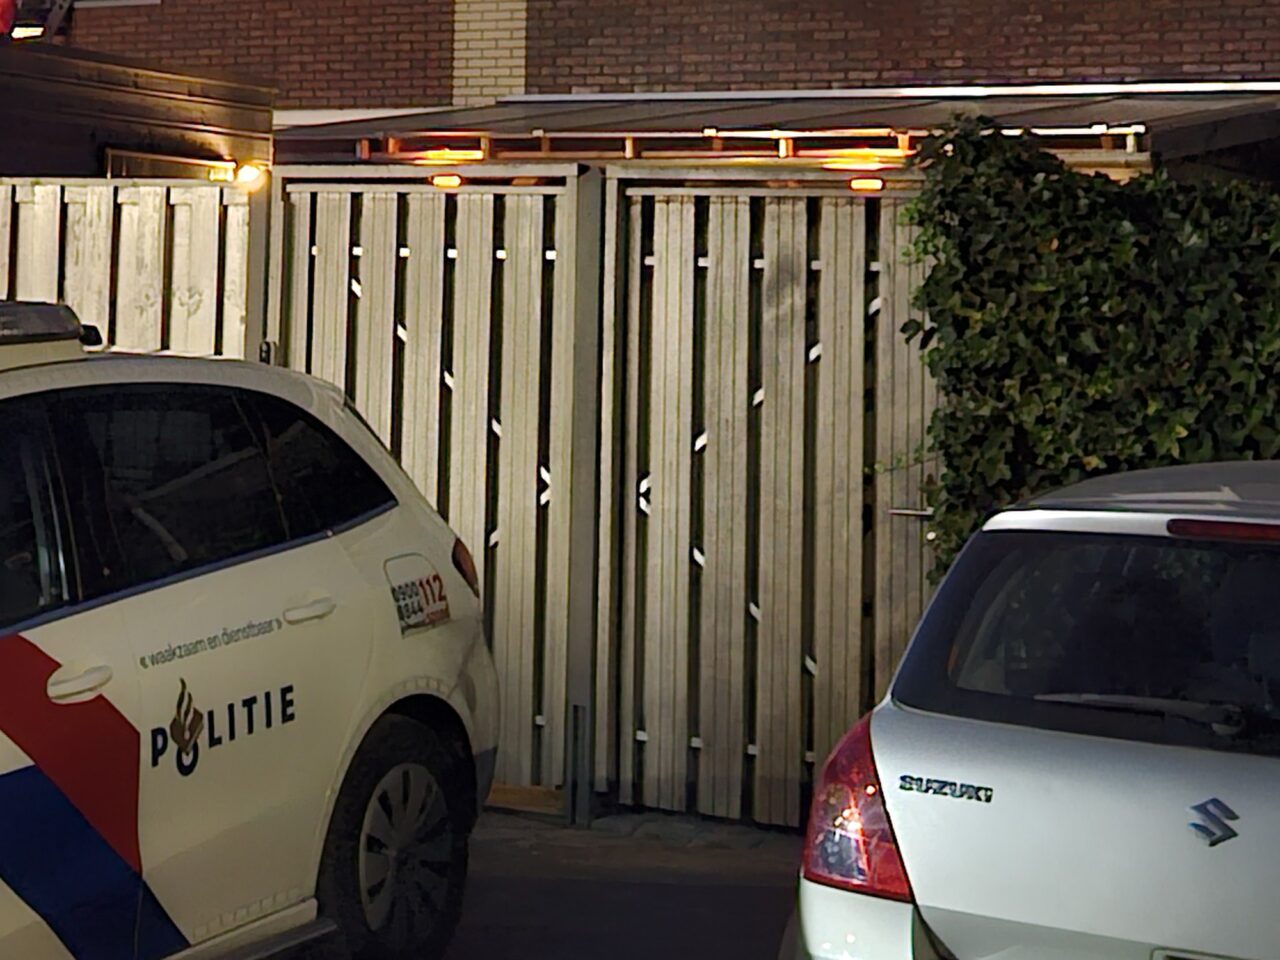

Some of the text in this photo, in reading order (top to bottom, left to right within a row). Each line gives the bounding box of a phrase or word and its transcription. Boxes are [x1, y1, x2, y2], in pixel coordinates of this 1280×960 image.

[419, 574, 447, 606] 112
[207, 633, 222, 650] en
[150, 684, 296, 777] POLITIE
[898, 774, 994, 803] SUZUKI
